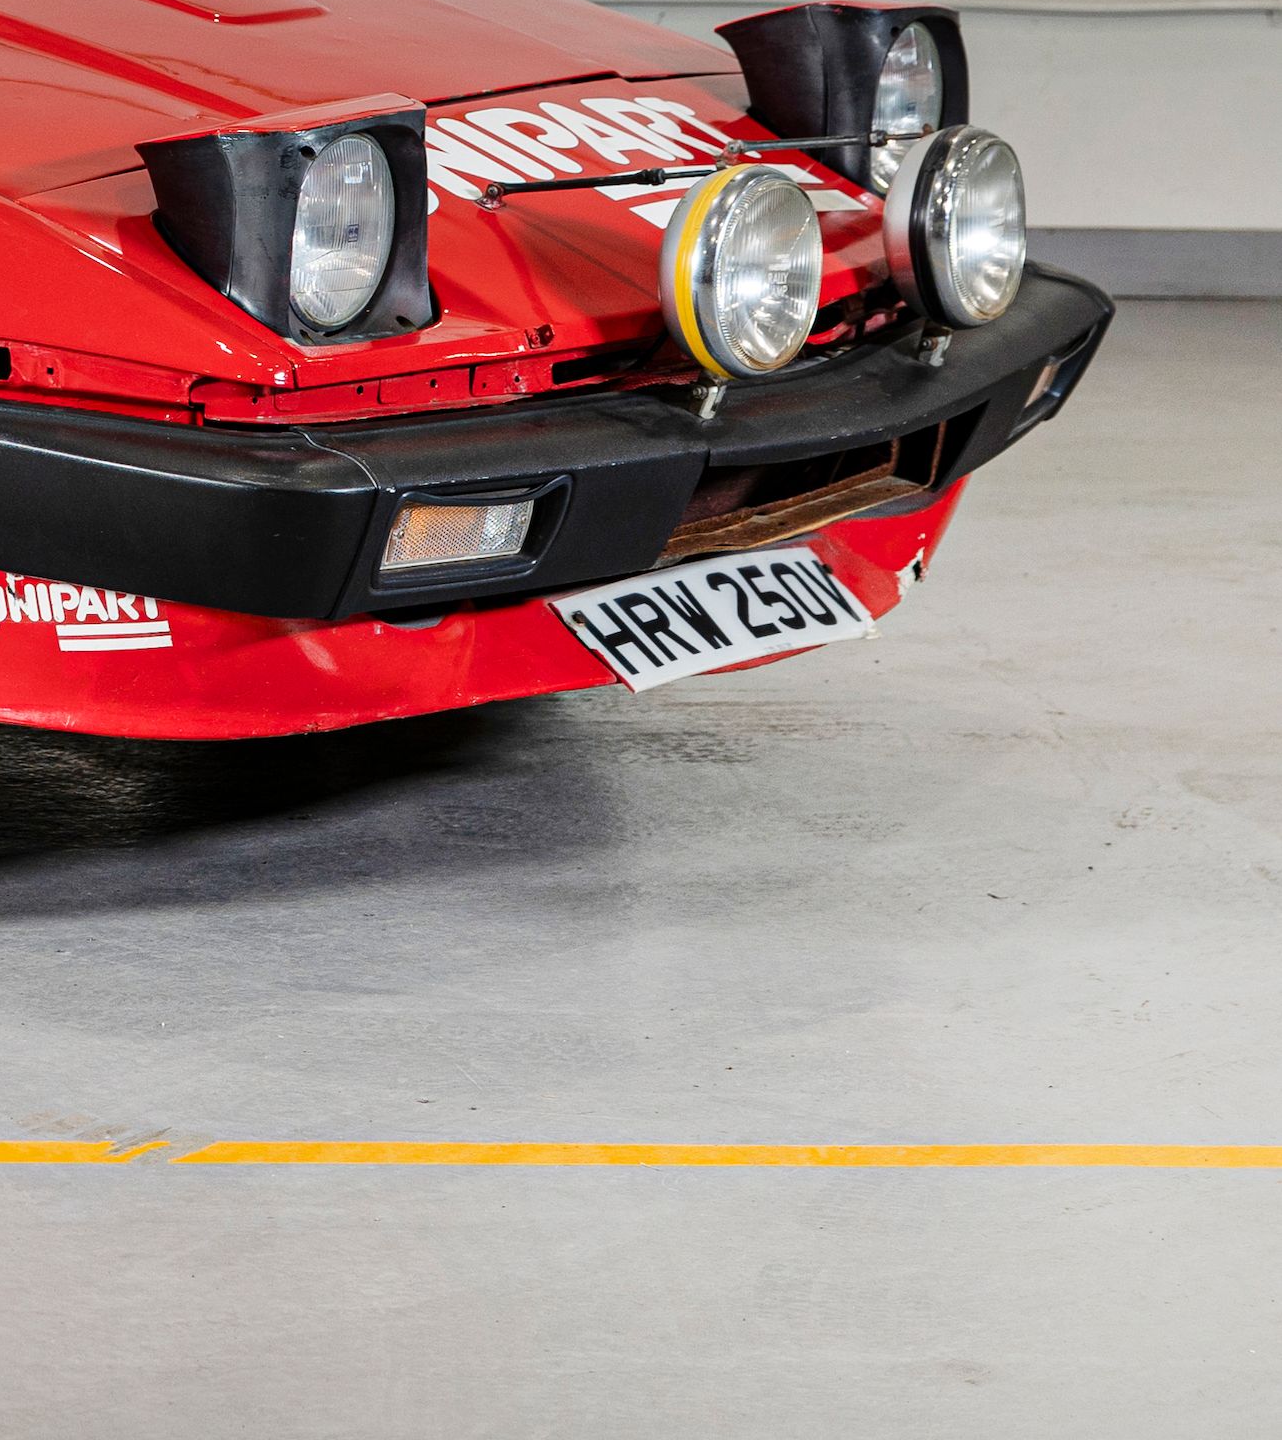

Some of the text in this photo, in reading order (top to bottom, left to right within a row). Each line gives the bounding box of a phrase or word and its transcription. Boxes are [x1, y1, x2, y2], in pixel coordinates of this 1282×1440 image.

[425, 97, 762, 215] NIPART
[581, 560, 862, 675] HRW 250V
